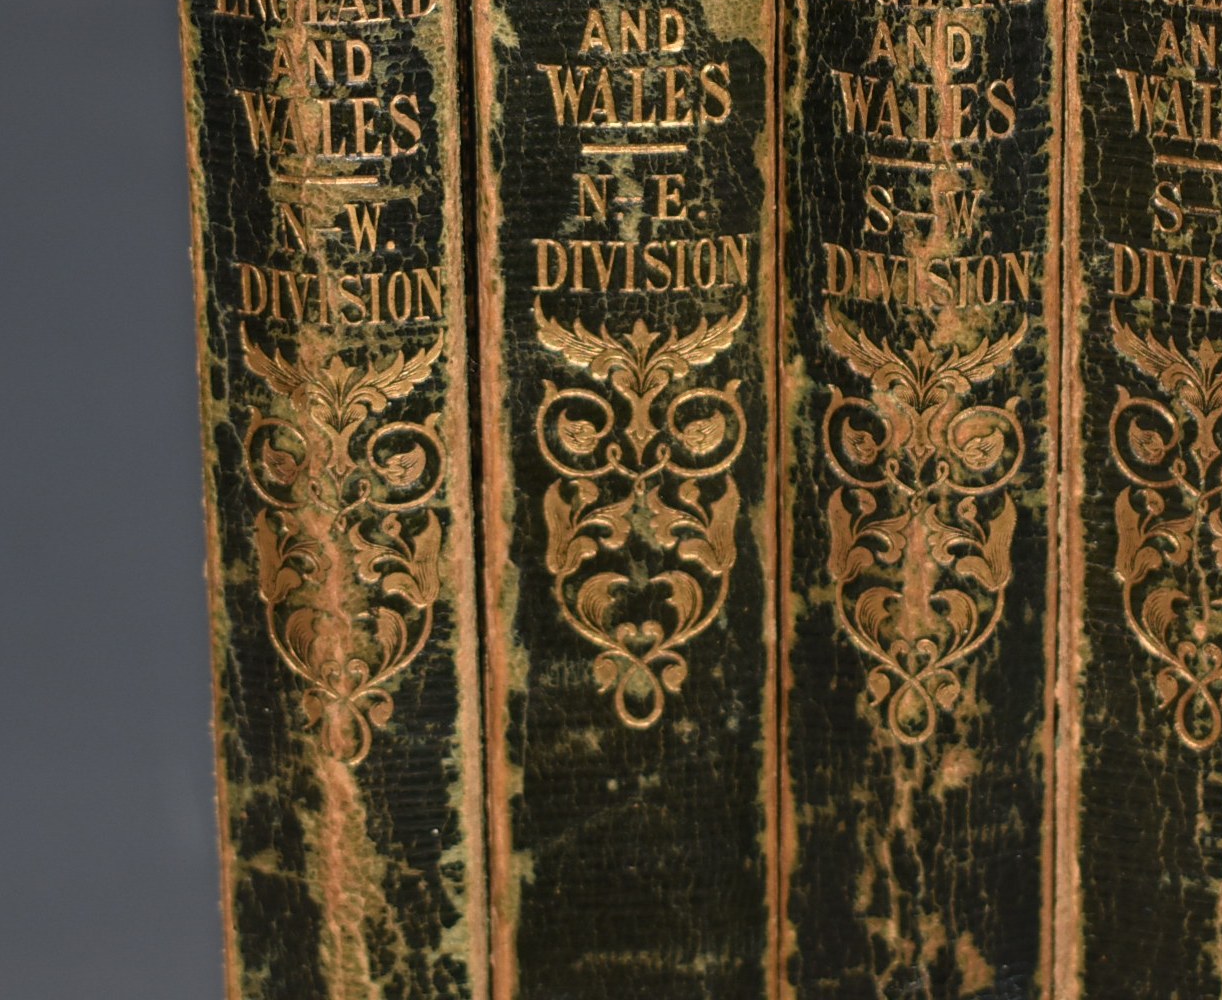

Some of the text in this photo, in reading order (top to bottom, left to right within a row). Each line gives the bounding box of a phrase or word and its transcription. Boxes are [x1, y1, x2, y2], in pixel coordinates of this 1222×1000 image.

[271, 38, 373, 85] AND
[577, 8, 686, 54] AND
[865, 19, 973, 71] AND
[234, 88, 422, 160] WALES
[536, 61, 733, 128] WALES
[830, 68, 1017, 143] WALES
[531, 234, 750, 293] DIVISION
[822, 242, 1031, 308] DIVISION
[232, 264, 444, 326] DIVISION
